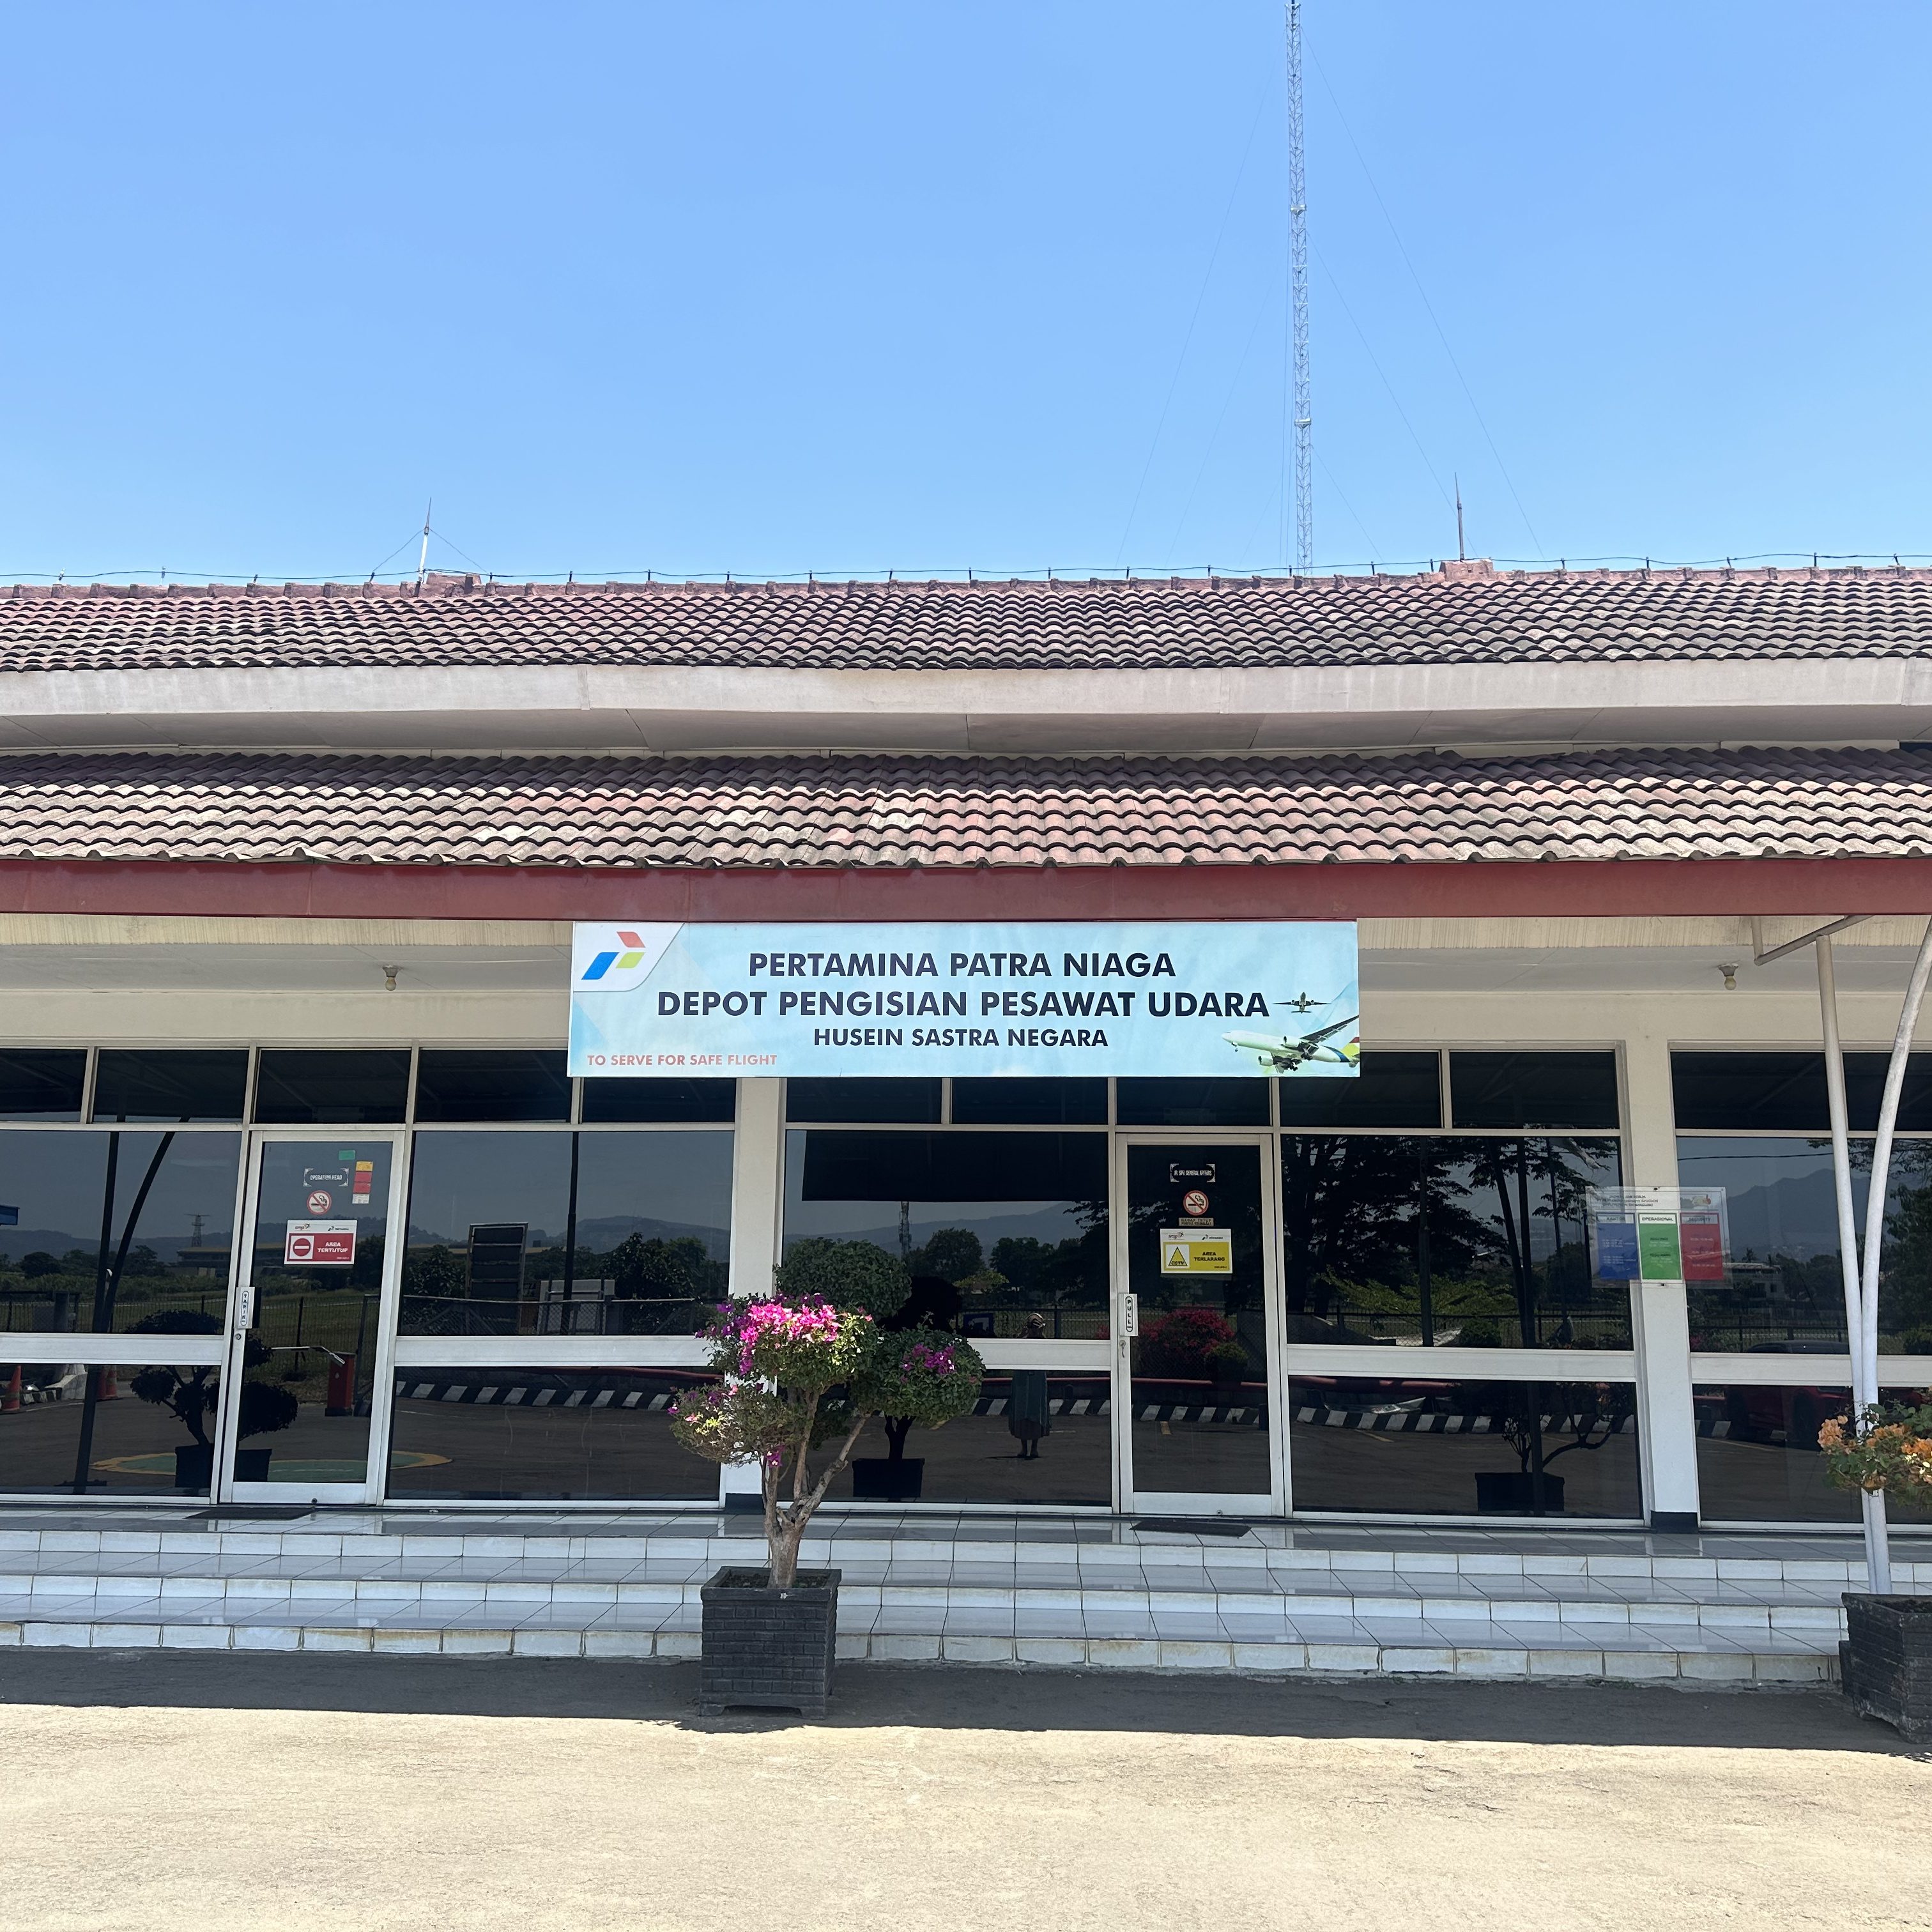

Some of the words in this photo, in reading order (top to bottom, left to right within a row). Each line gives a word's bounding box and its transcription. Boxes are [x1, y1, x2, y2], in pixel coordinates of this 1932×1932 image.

[749, 953, 937, 977] PERTAMINA
[950, 953, 1051, 977] PATRA
[1064, 953, 1176, 977] NIAGA
[658, 991, 767, 1016] DEPOT
[779, 991, 967, 1016] PENGISIAN
[981, 991, 1136, 1017] PESAWAT
[1148, 992, 1269, 1017] UDARA
[814, 1028, 903, 1046] HUSEIN
[911, 1028, 1000, 1046] SASTRA
[1008, 1029, 1108, 1046] NEGARA
[587, 1055, 606, 1066] TO
[611, 1055, 653, 1066] SERVE
[657, 1054, 686, 1066] FOR
[689, 1054, 723, 1066] SAFE
[728, 1054, 778, 1066] FLIGHT
